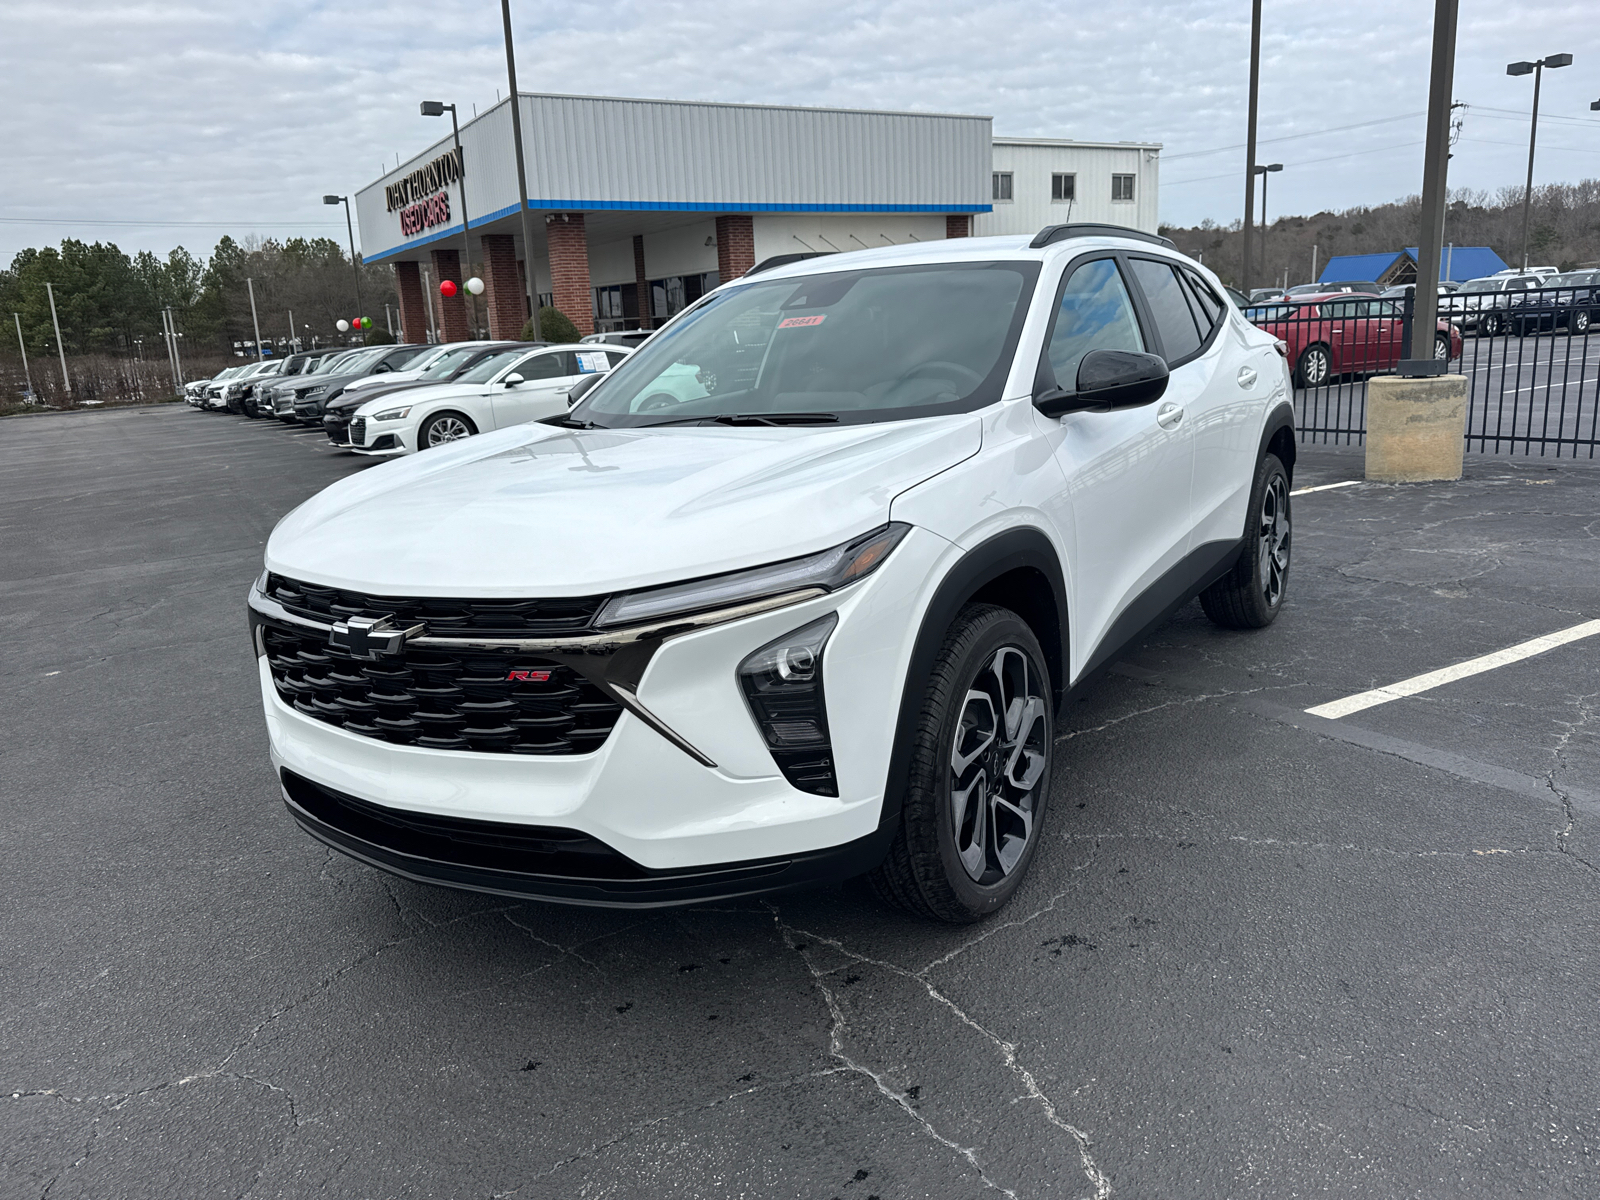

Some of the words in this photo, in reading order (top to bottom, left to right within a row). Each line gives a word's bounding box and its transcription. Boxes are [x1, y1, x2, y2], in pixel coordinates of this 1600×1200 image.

[385, 178, 409, 212] JOHN
[406, 146, 465, 201] THORNTON
[400, 204, 424, 236] USED
[421, 191, 451, 228] CARS
[784, 317, 818, 327] 26641
[505, 670, 552, 681] RS
